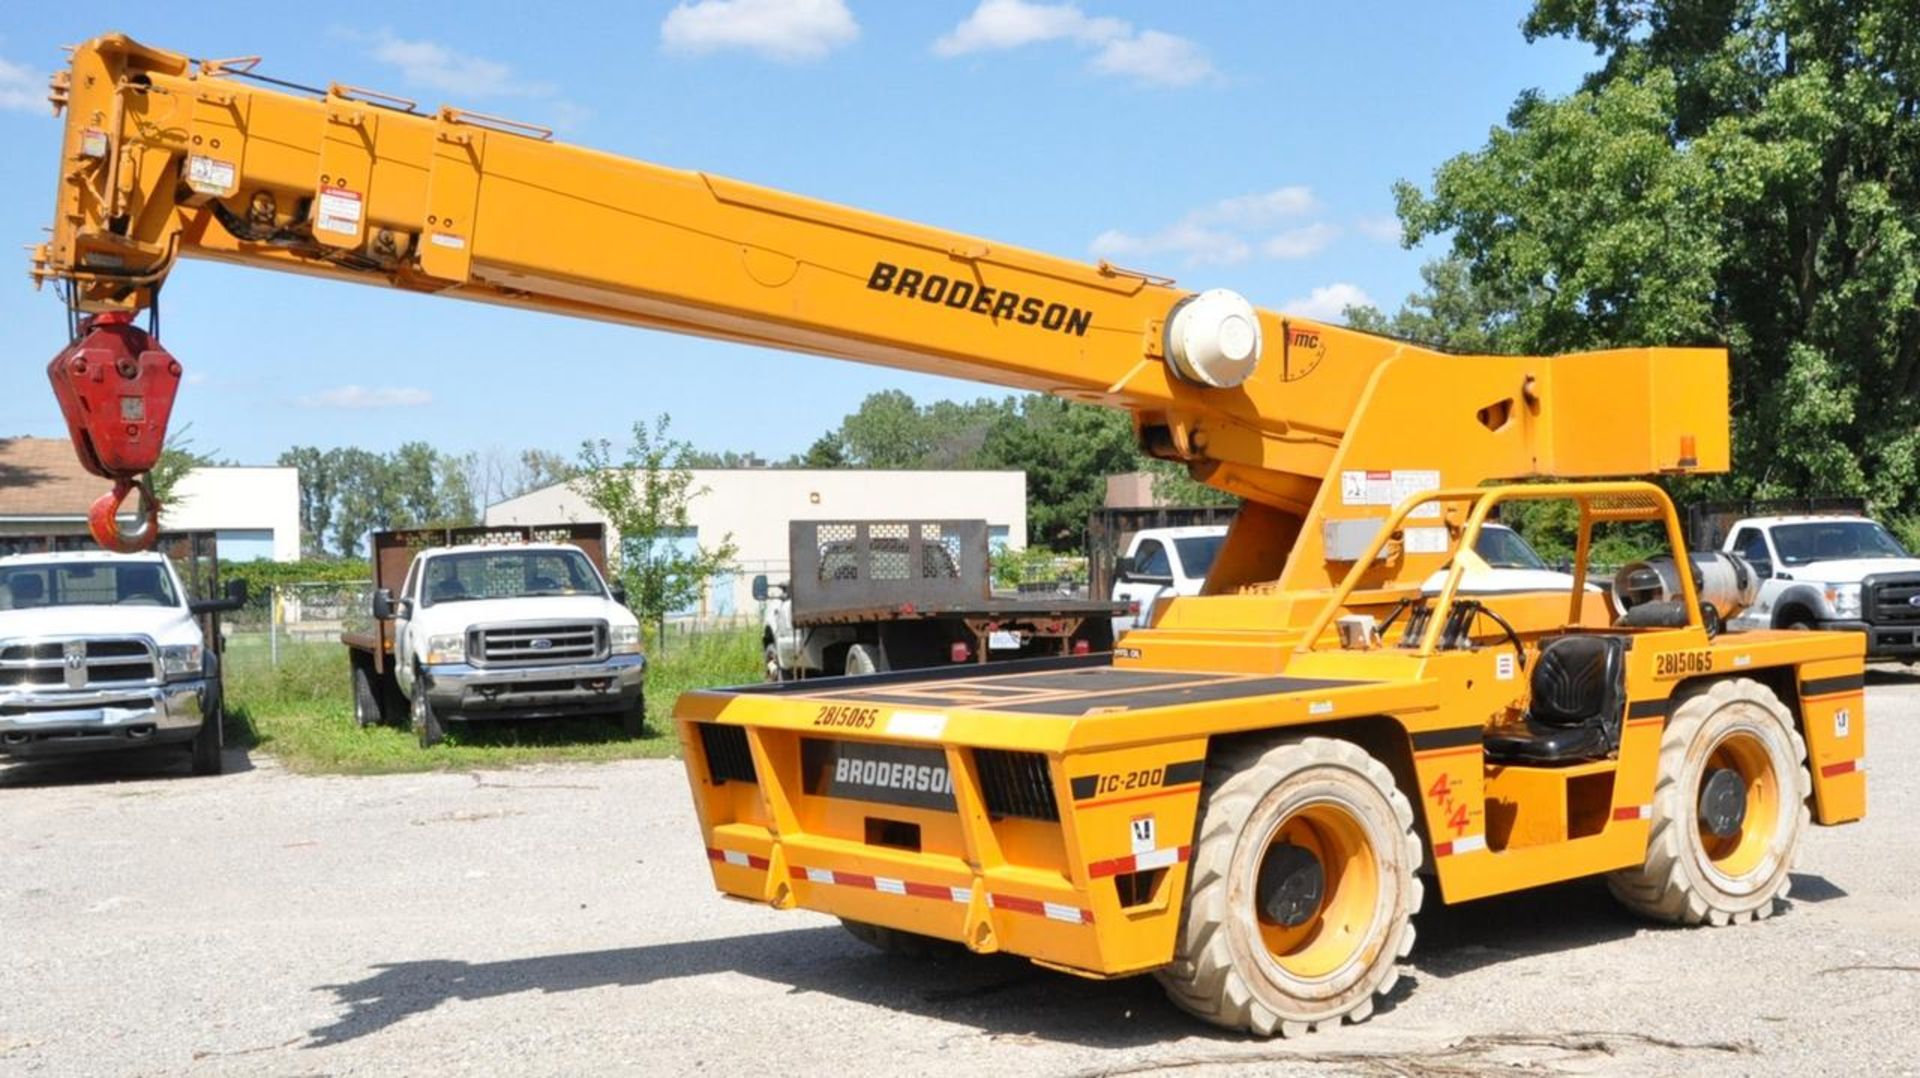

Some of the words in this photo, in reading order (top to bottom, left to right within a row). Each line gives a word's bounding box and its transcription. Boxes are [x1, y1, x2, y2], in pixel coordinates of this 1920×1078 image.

[867, 262, 1093, 336] BRODERSON
[1657, 651, 1712, 674] 2815065
[814, 706, 878, 728] 2815065
[1099, 769, 1162, 794] IC-200
